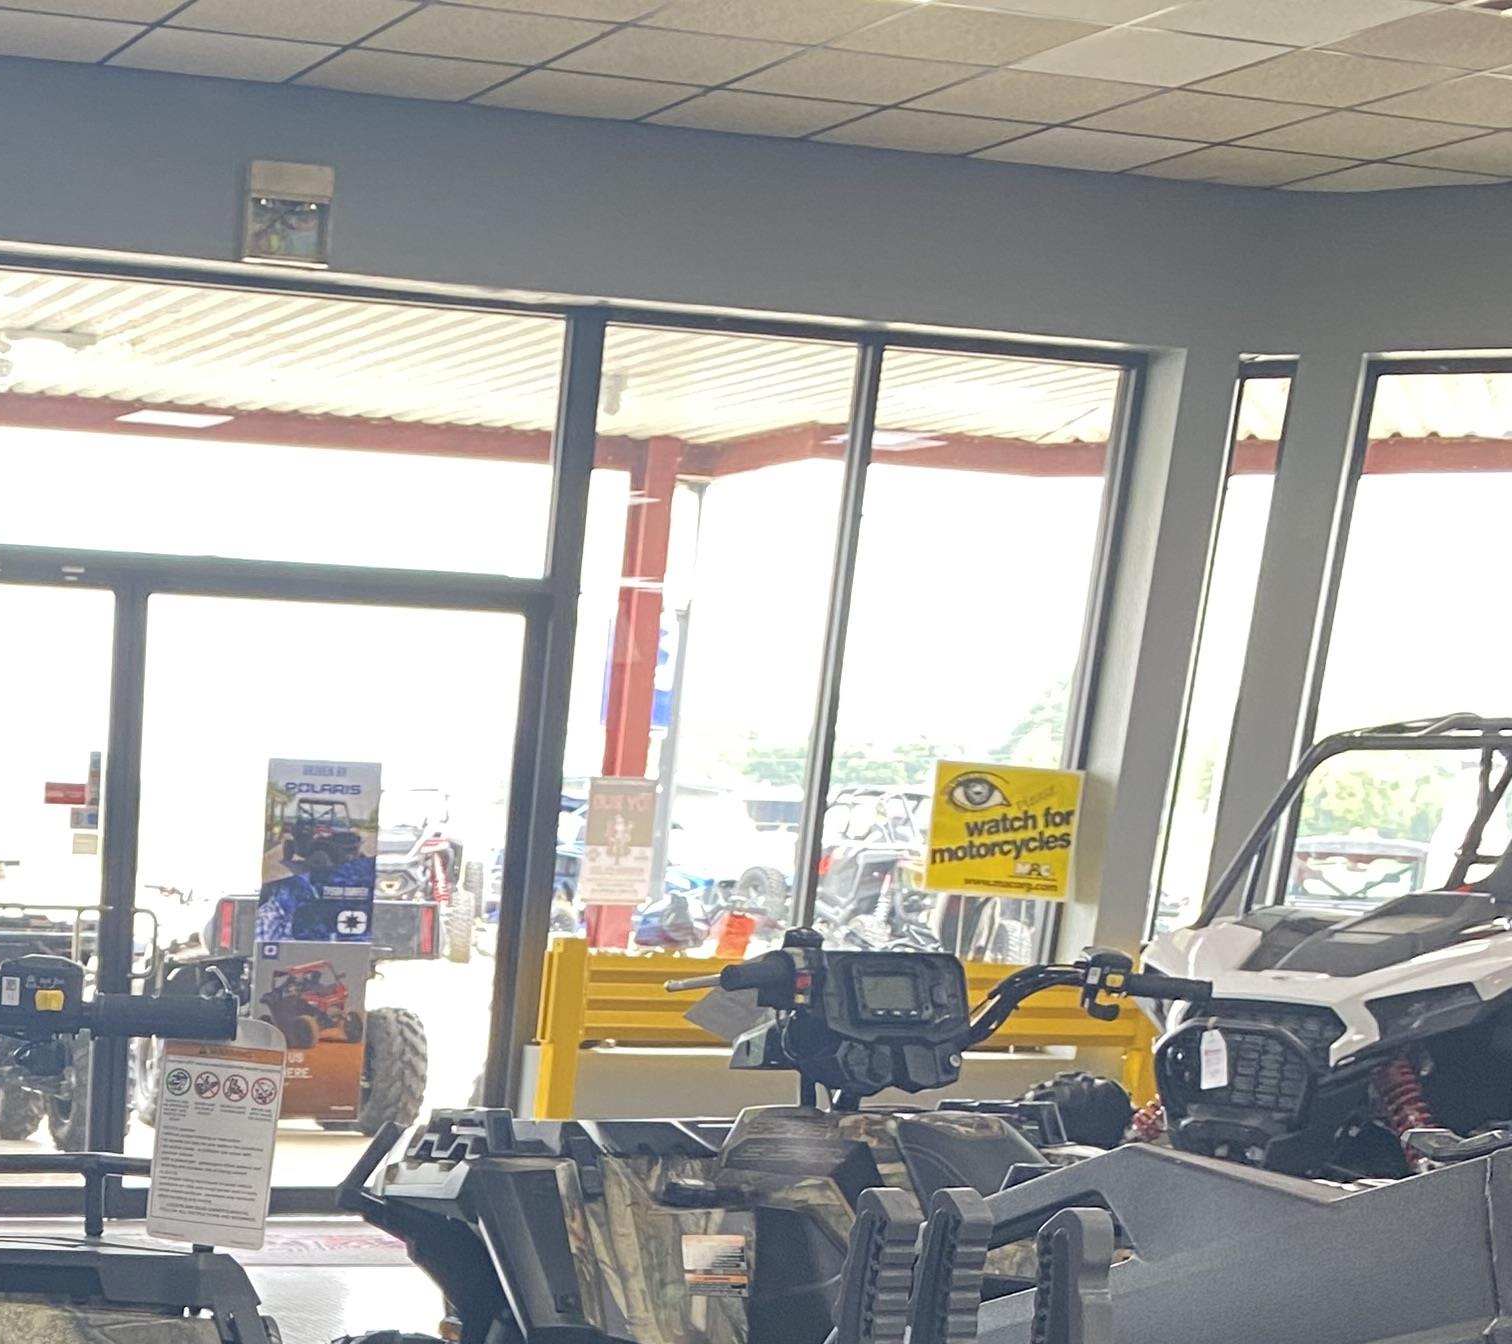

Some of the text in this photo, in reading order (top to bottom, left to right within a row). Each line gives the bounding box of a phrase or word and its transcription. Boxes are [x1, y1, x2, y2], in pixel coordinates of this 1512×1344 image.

[285, 782, 361, 795] POLARIS
[965, 807, 1075, 837] watch for
[930, 831, 1071, 865] motorcycles
